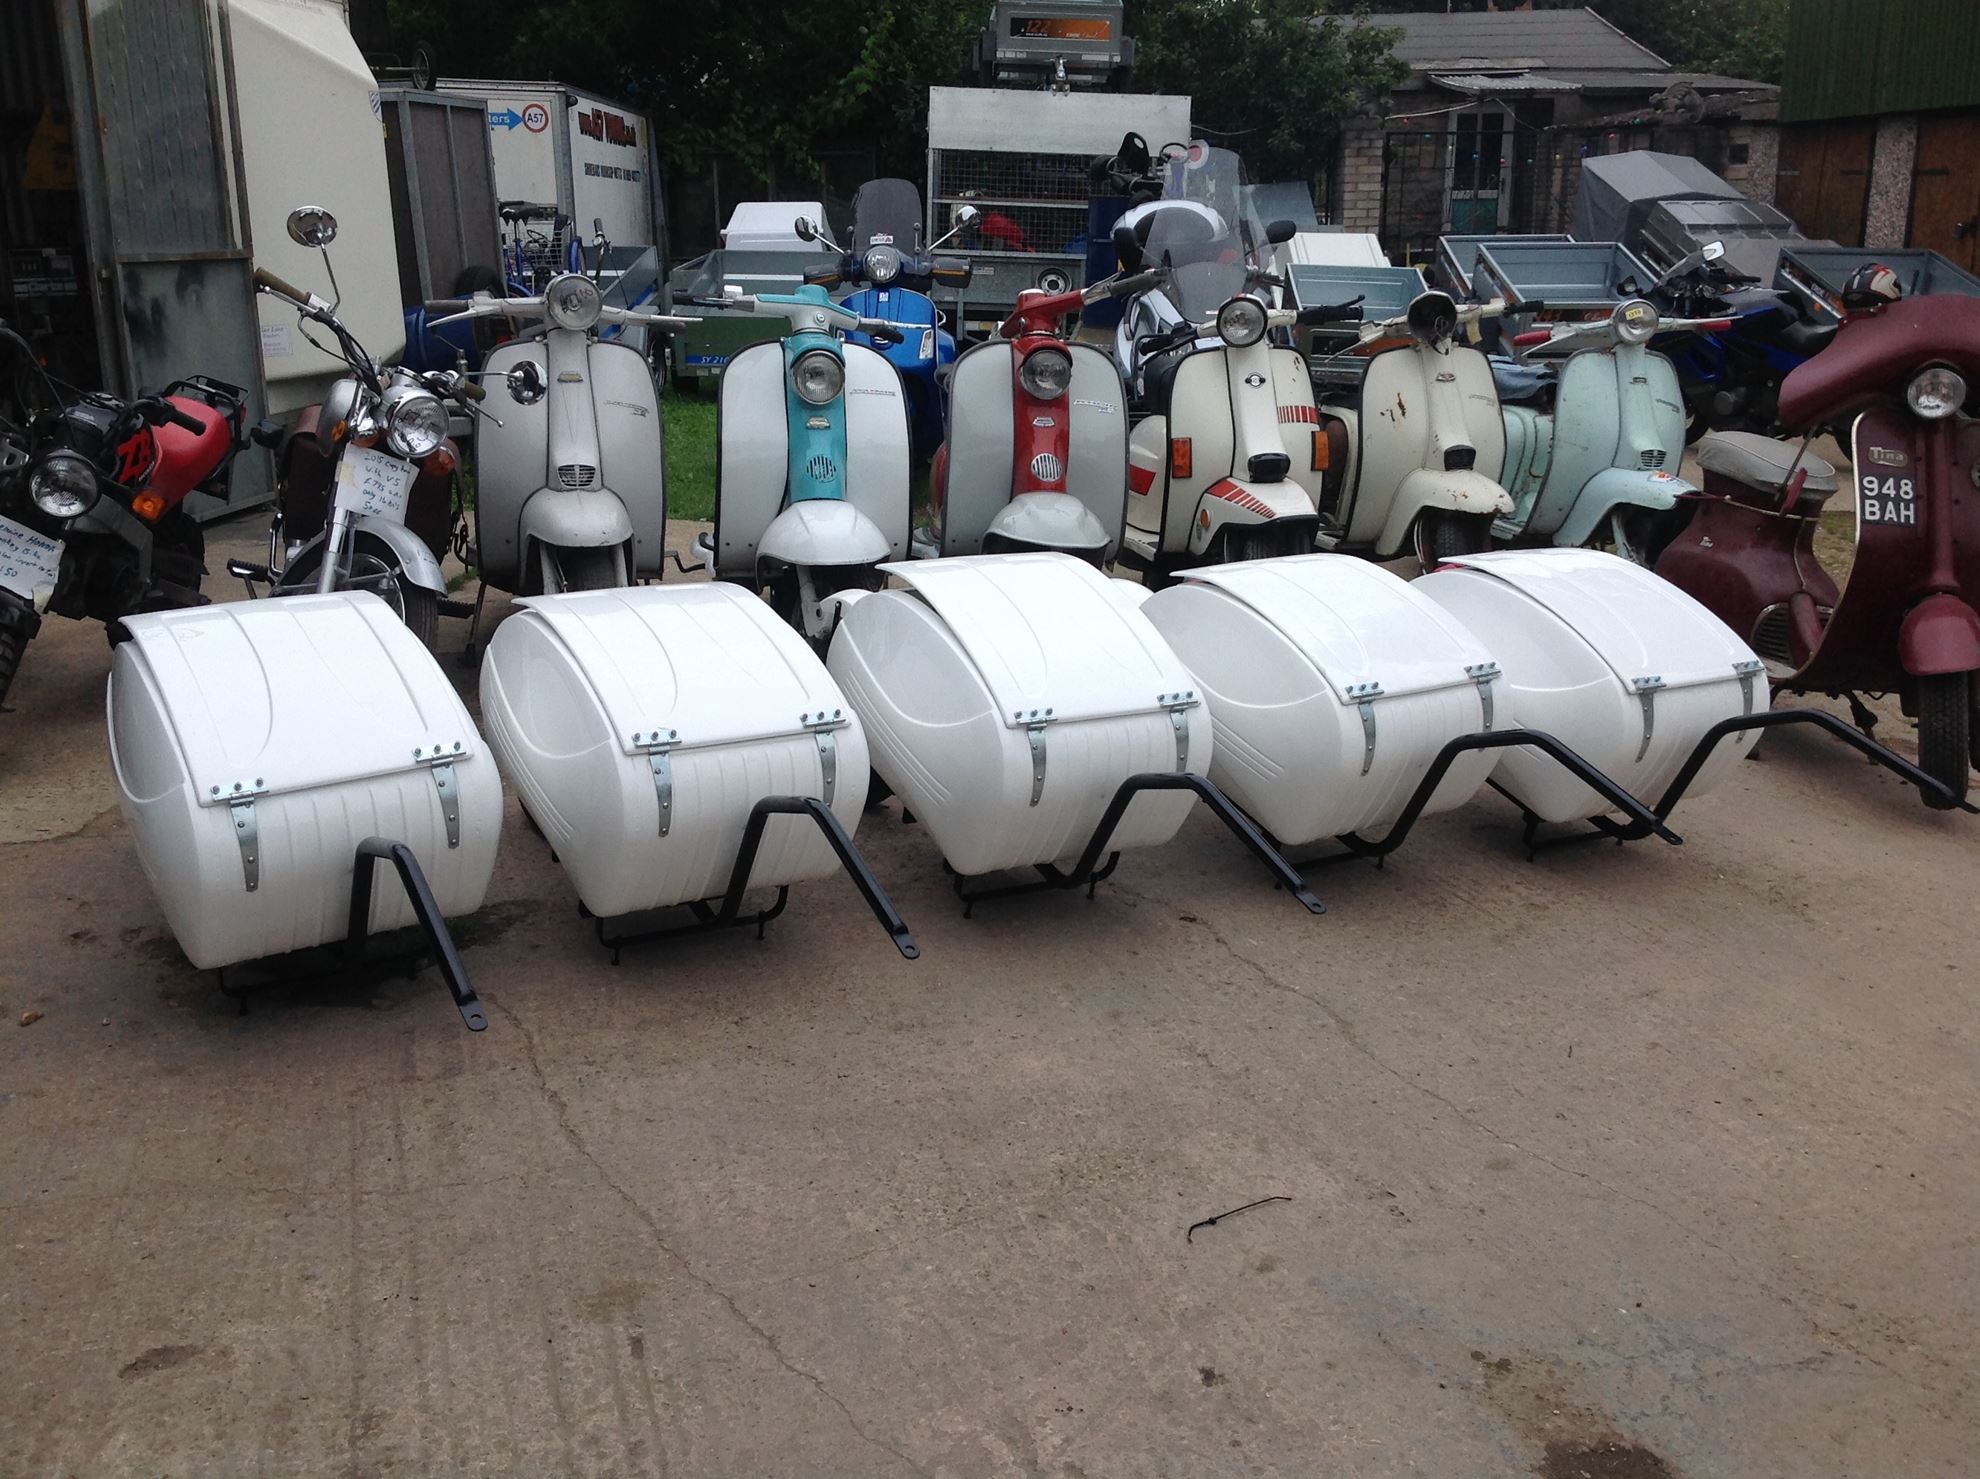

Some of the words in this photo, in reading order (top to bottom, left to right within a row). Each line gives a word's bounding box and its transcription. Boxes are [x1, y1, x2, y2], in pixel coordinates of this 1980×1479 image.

[527, 113, 544, 124] A57
[1869, 446, 1905, 461] Tina
[1862, 476, 1914, 500] 948
[1864, 499, 1916, 525] BAH
[0, 524, 24, 539] enuine
[0, 536, 19, 553] onkey
